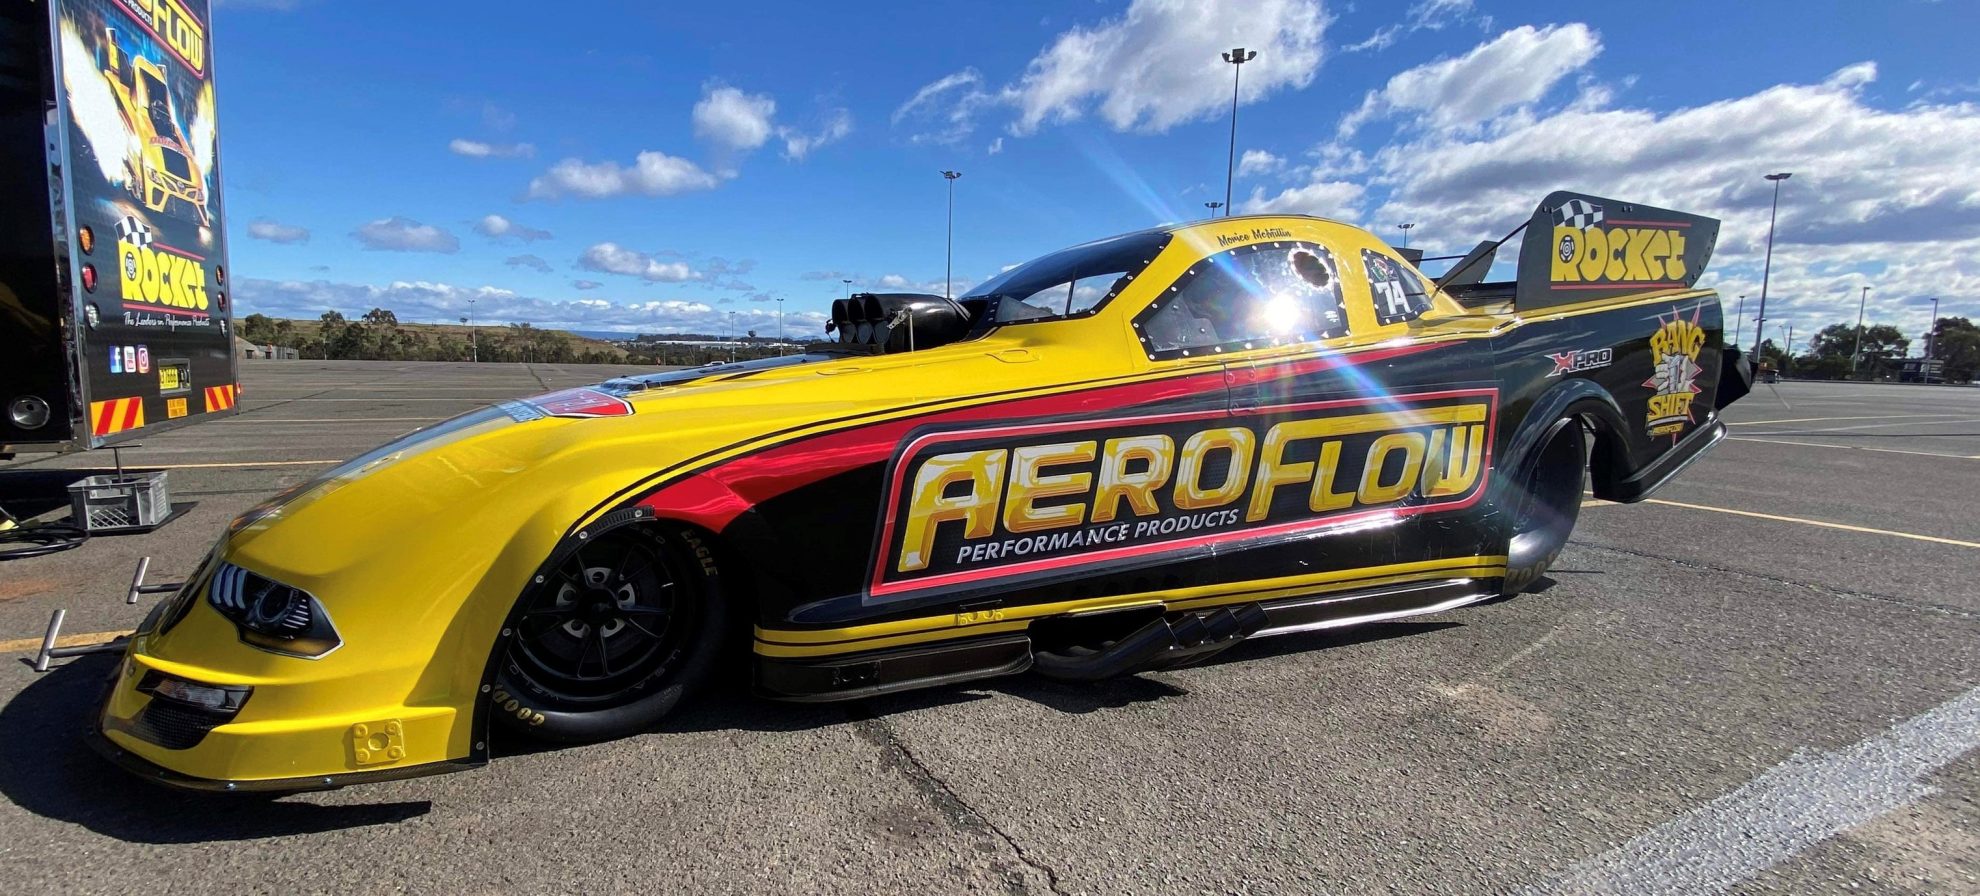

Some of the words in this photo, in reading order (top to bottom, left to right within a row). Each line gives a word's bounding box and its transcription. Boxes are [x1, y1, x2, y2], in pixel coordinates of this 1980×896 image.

[1650, 319, 1705, 366] BANG
[1648, 392, 1695, 421] SHIFT
[898, 403, 1486, 572] AEROFLOW
[680, 529, 718, 577] EAGLE
[956, 523, 1129, 564] PERFORMANCE
[1134, 508, 1238, 540] PRODUCTS
[493, 688, 544, 727] GOOD
